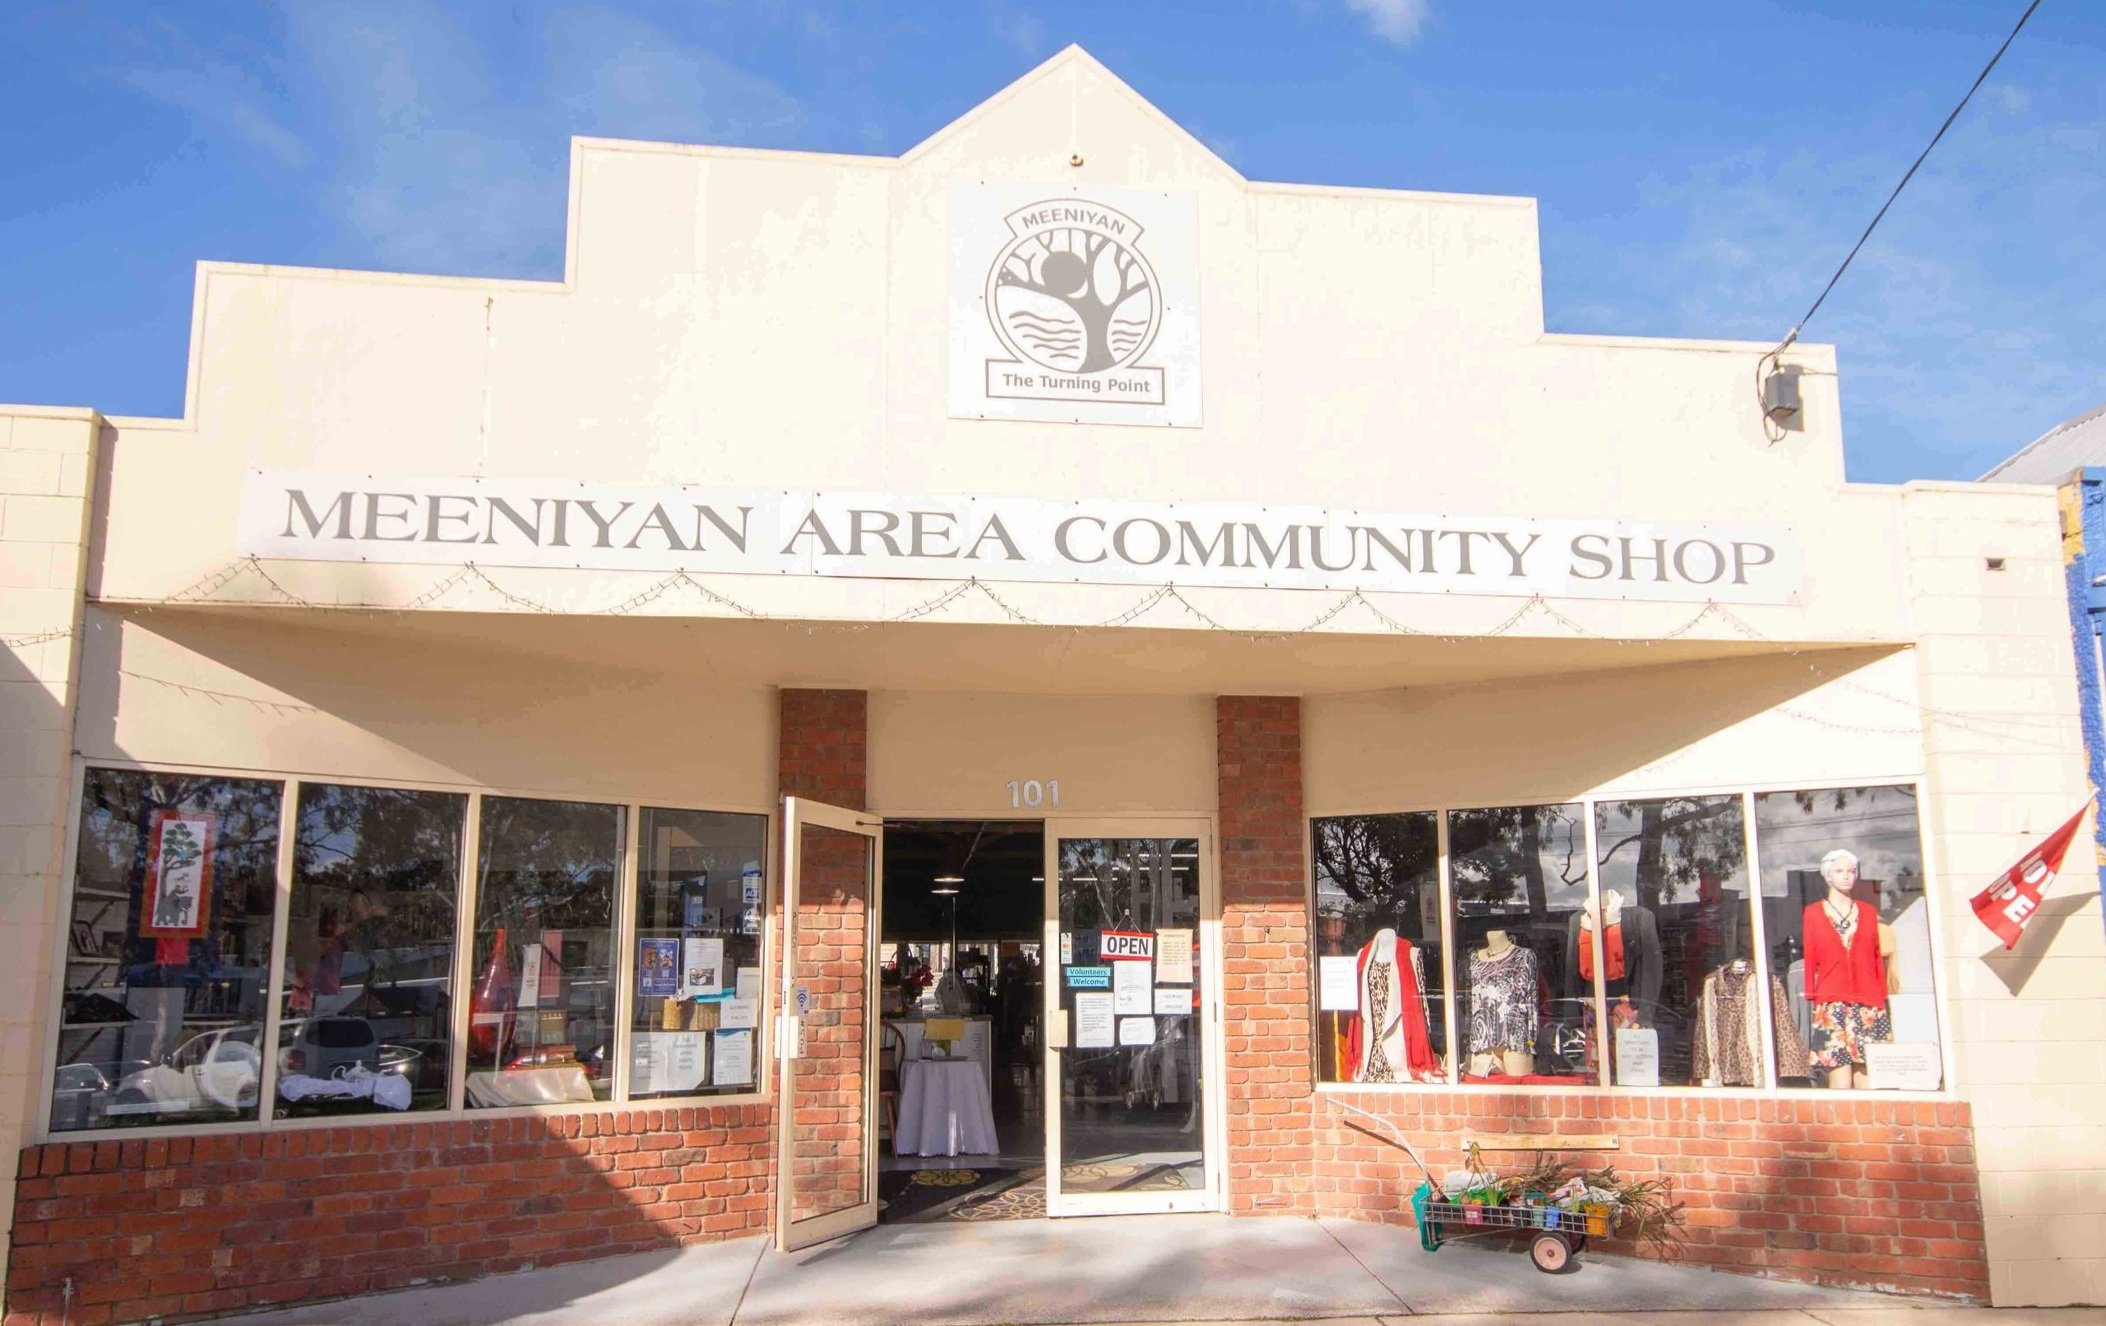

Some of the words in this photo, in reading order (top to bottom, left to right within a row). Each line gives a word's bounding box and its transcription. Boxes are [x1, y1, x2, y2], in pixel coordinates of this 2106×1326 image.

[1021, 207, 1126, 235] MEENIYAN
[1002, 373, 1034, 388] The
[1039, 375, 1101, 393] Turning
[1108, 378, 1151, 393] Point
[279, 488, 754, 554] MEENIYAN
[779, 507, 1027, 562] AREA
[1053, 515, 1542, 577] COMMUNITY
[1568, 533, 1776, 585] SHOP
[1006, 779, 1059, 809] 101
[1107, 936, 1149, 955] OPEN
[1069, 968, 1107, 977] Volunteers
